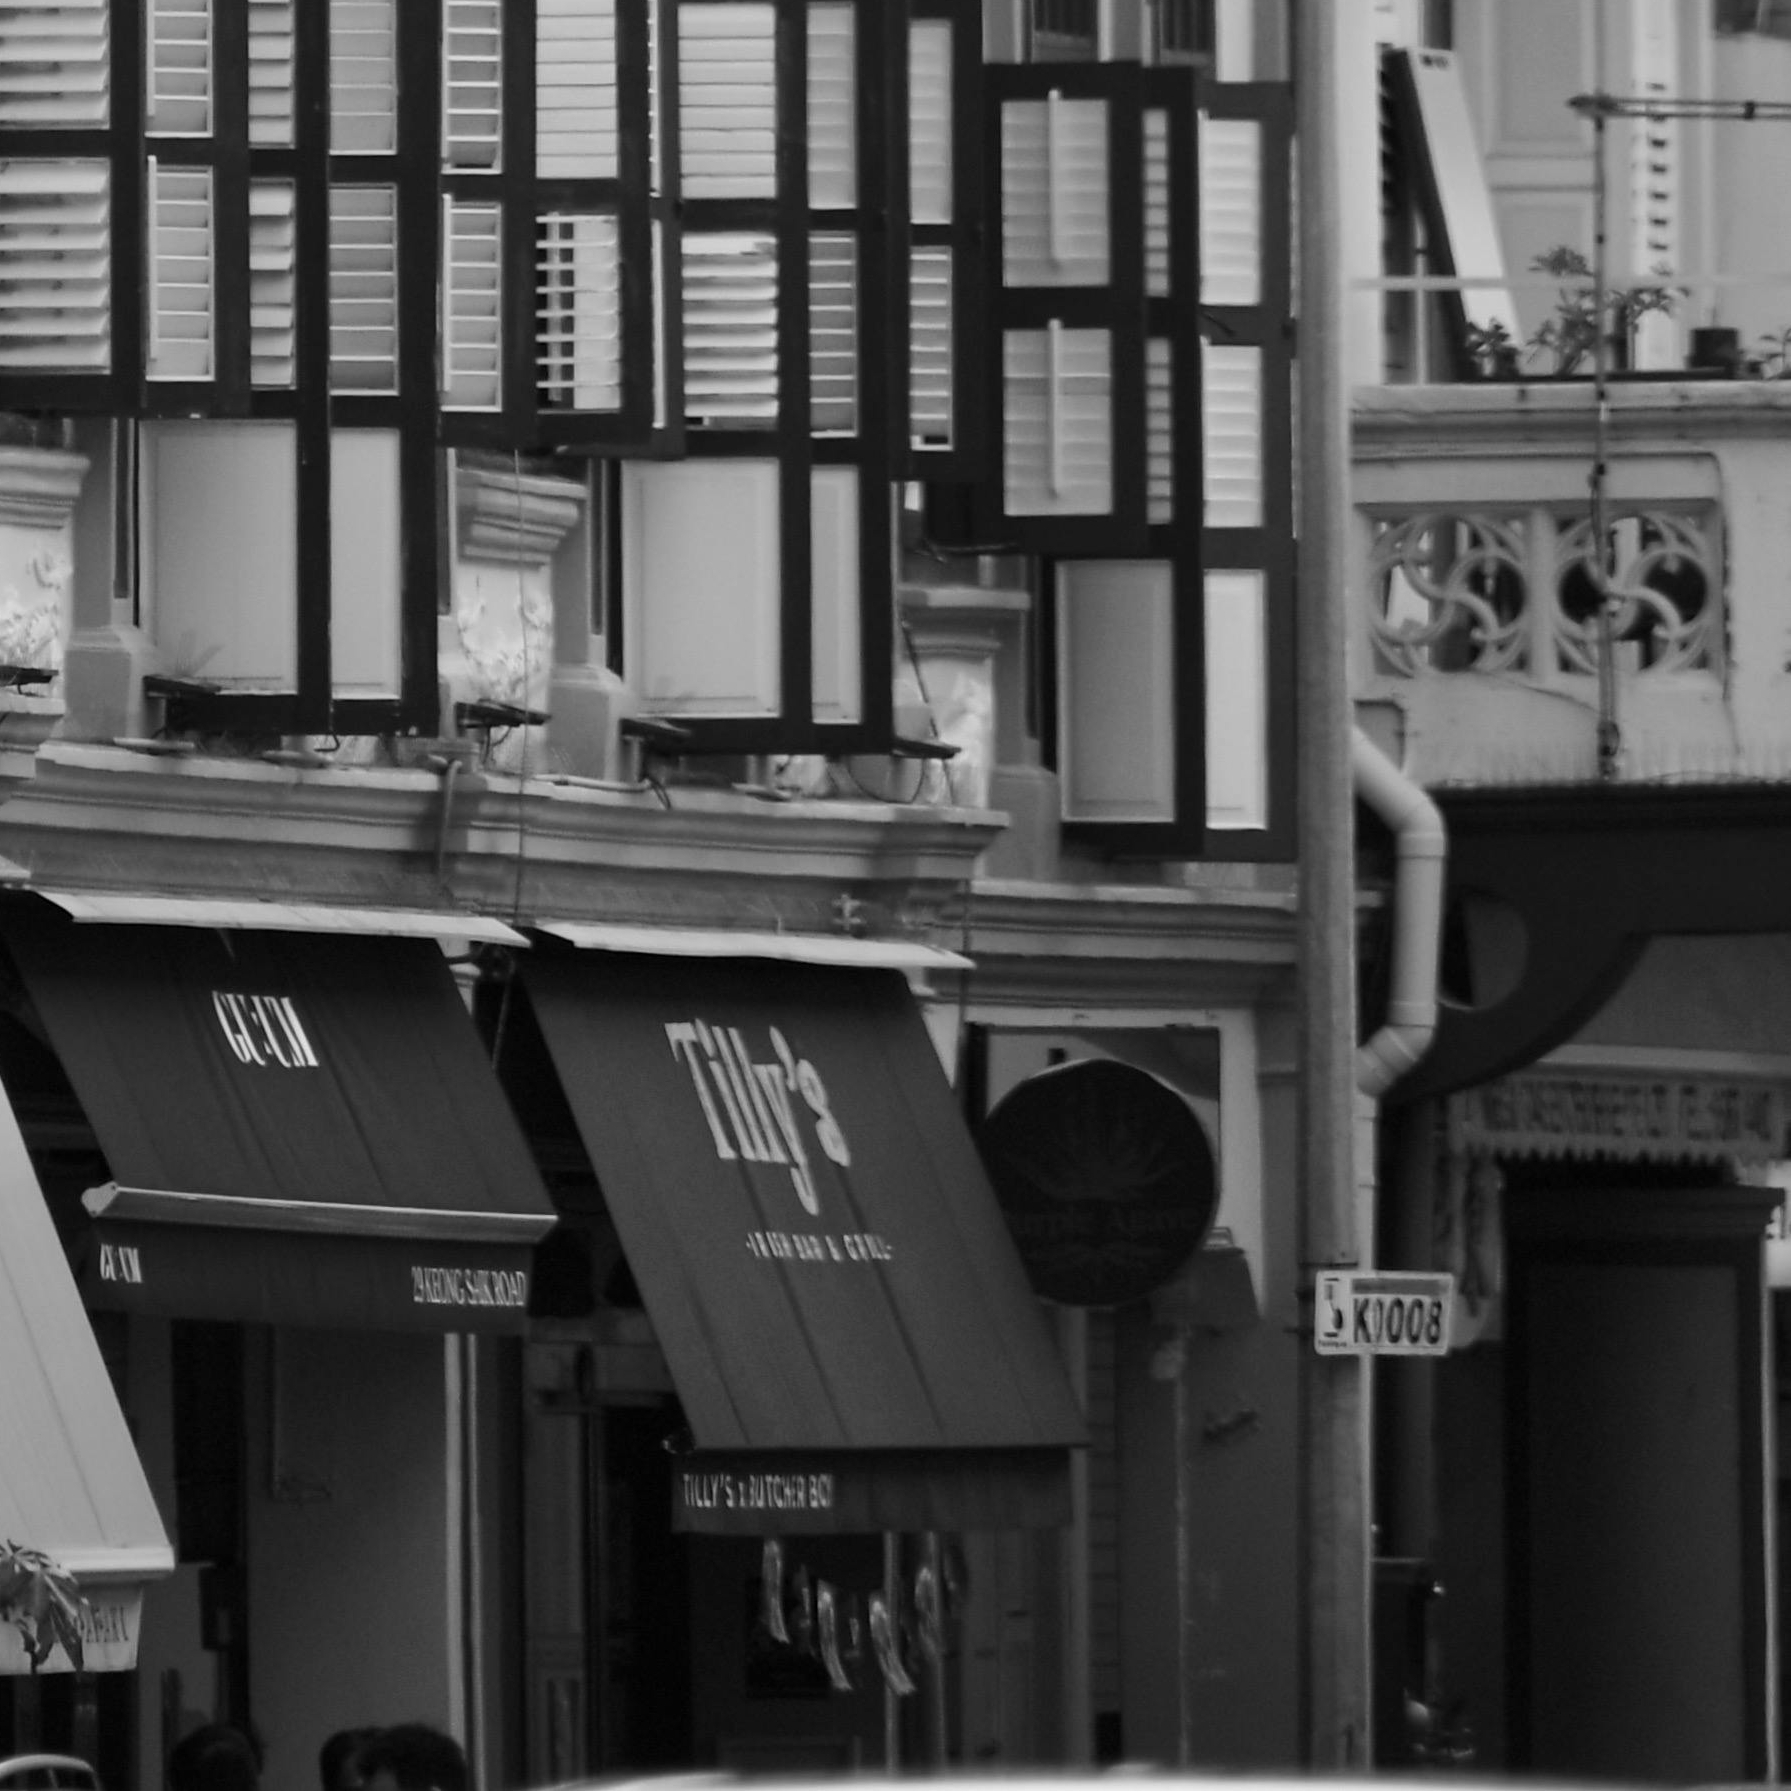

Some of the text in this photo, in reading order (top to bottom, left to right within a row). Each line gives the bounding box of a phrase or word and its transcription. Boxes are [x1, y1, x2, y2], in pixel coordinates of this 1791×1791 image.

[664, 1018, 851, 1216] Tilly's
[792, 1233, 824, 1260] BAR
[424, 1267, 465, 1304] KEONG
[491, 1269, 527, 1307] ROAD
[683, 1473, 734, 1508] TILLY'S
[749, 1473, 806, 1508] BUTCHER
